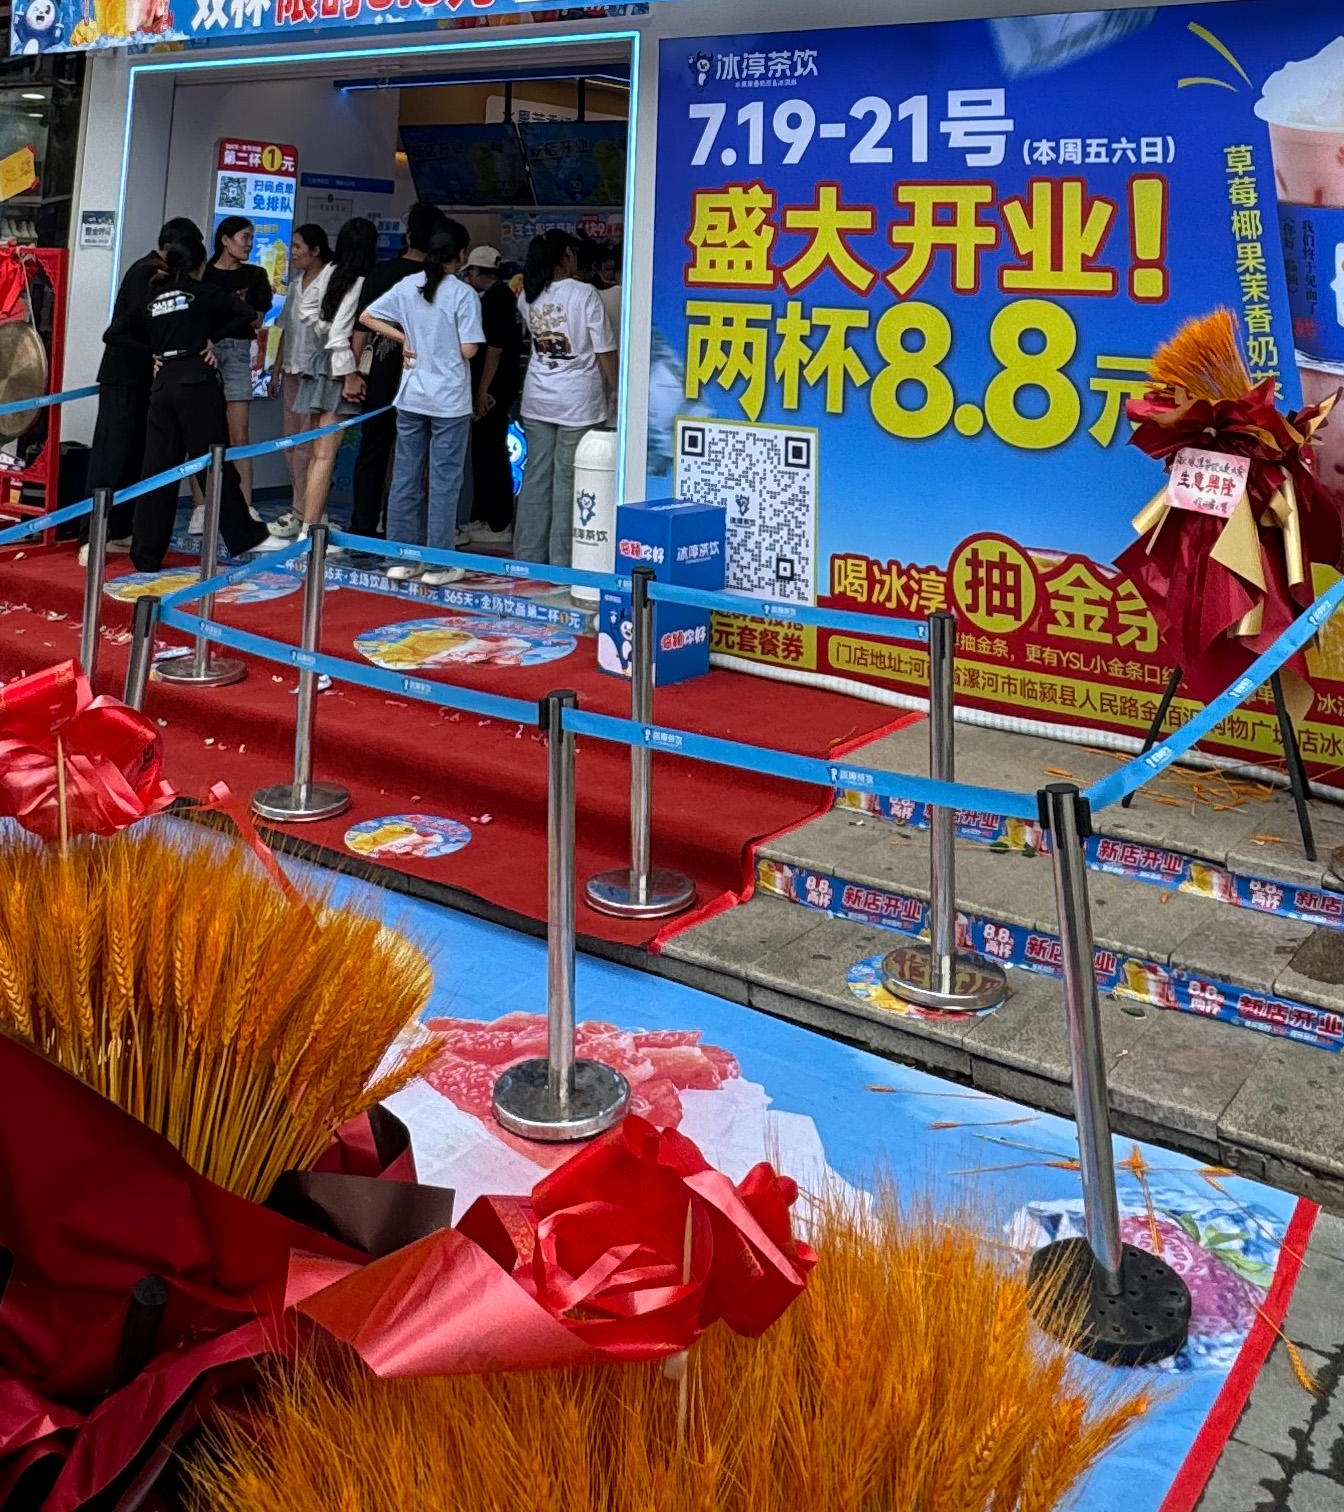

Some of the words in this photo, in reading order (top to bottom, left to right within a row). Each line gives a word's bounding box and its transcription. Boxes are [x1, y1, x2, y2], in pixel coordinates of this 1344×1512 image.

[716, 49, 818, 80] 冰淳茶饮
[688, 88, 1015, 169] 7.19-21号
[223, 147, 296, 172] 第二杯1元
[252, 196, 294, 213] 免排队
[254, 179, 294, 195] 扫码点单
[686, 177, 1168, 300] 盛大开业!
[709, 621, 805, 663] 元套餐券
[1097, 839, 1184, 876] 新店开业
[842, 885, 924, 923] 新店开业
[1026, 935, 1118, 976] 新店业
[1238, 994, 1344, 1038] 新店开业
